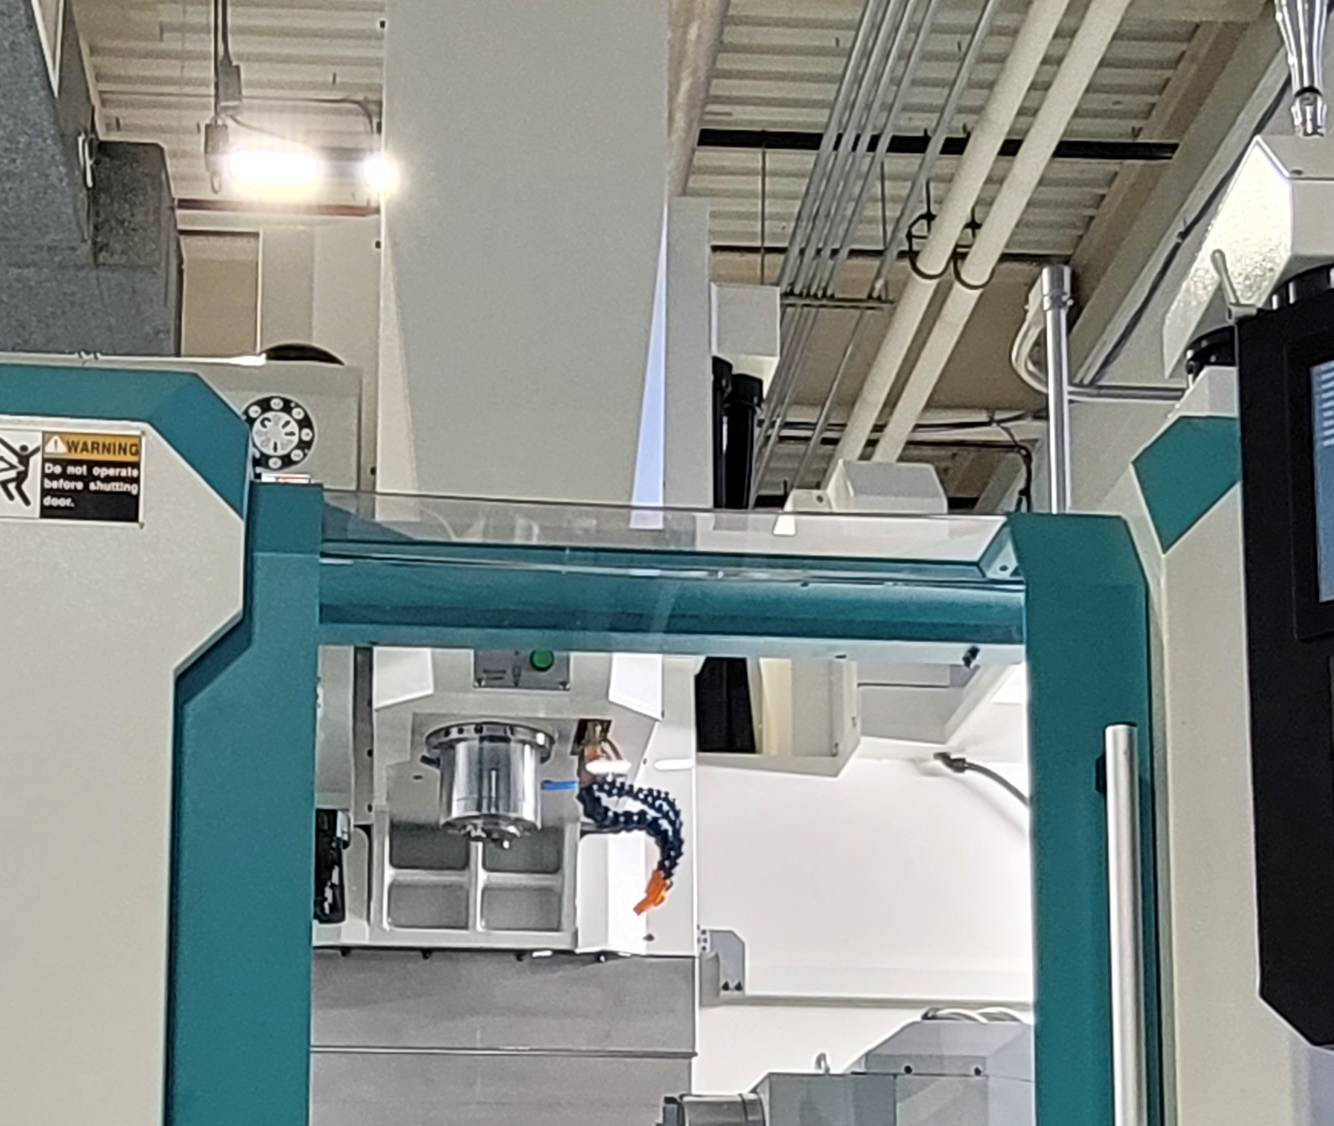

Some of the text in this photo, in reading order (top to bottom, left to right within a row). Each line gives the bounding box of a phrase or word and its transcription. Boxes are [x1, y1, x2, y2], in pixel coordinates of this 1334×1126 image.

[67, 440, 139, 456] WARNING
[44, 463, 139, 479] Do not operate
[43, 478, 139, 496] before shutting
[42, 495, 75, 508] door.
